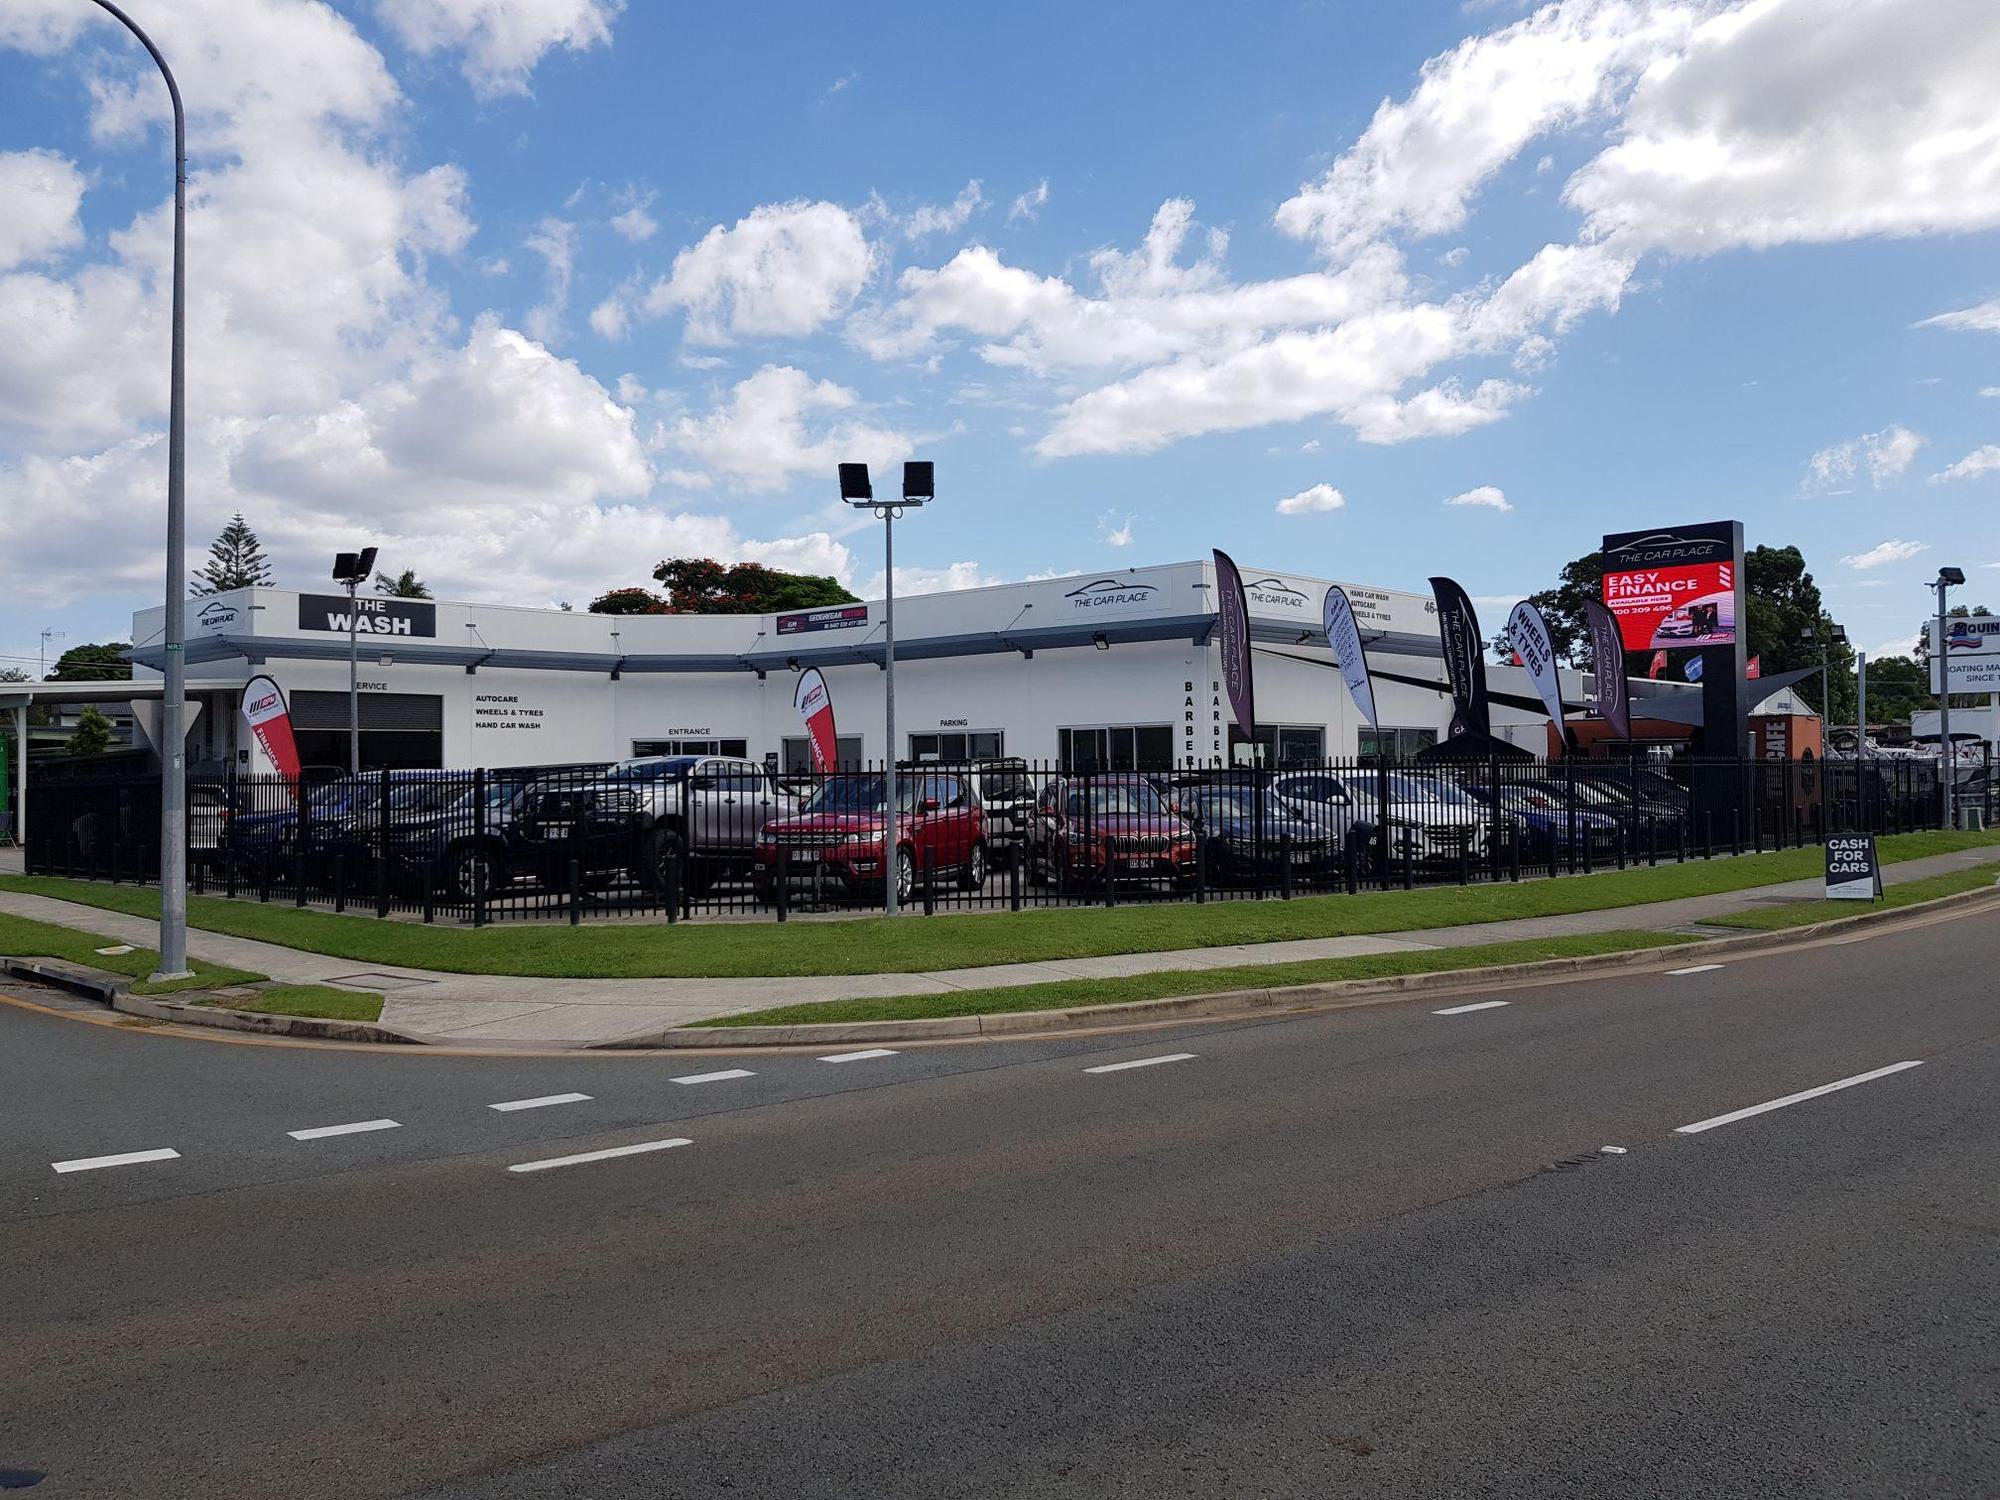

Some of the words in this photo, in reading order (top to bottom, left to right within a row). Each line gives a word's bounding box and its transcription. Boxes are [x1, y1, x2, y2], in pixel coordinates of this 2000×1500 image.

[1620, 553, 1642, 563] THE
[1644, 550, 1670, 561] CAR
[1672, 545, 1714, 558] PLACE
[1608, 572, 1659, 587] EASY
[1608, 579, 1698, 597] FINANCE
[1074, 598, 1092, 608] THE
[1094, 596, 1114, 606] CAR
[1116, 592, 1149, 603] PLACE
[1251, 593, 1264, 602] THE
[1265, 595, 1280, 604] CAR
[1281, 596, 1304, 607] PLACE
[1350, 590, 1364, 598] HAND
[1375, 593, 1389, 601] WASH
[1610, 597, 1649, 606] AVAILABLE
[355, 599, 386, 612] THE
[1351, 600, 1376, 609] AUTOCARE
[1376, 612, 1392, 621] TYRES
[327, 612, 411, 635] WASH
[1518, 608, 1551, 662] WHEELS
[1511, 622, 1518, 636] &
[1518, 632, 1543, 677] TYRES
[1966, 674, 1995, 682] SINCE
[356, 682, 388, 690] ERVICE
[475, 708, 509, 716] WHEELS
[1185, 681, 1194, 765] BARBER
[1828, 838, 1869, 850] CASH
[1834, 851, 1864, 861] FOR
[1829, 862, 1869, 873] CARS
